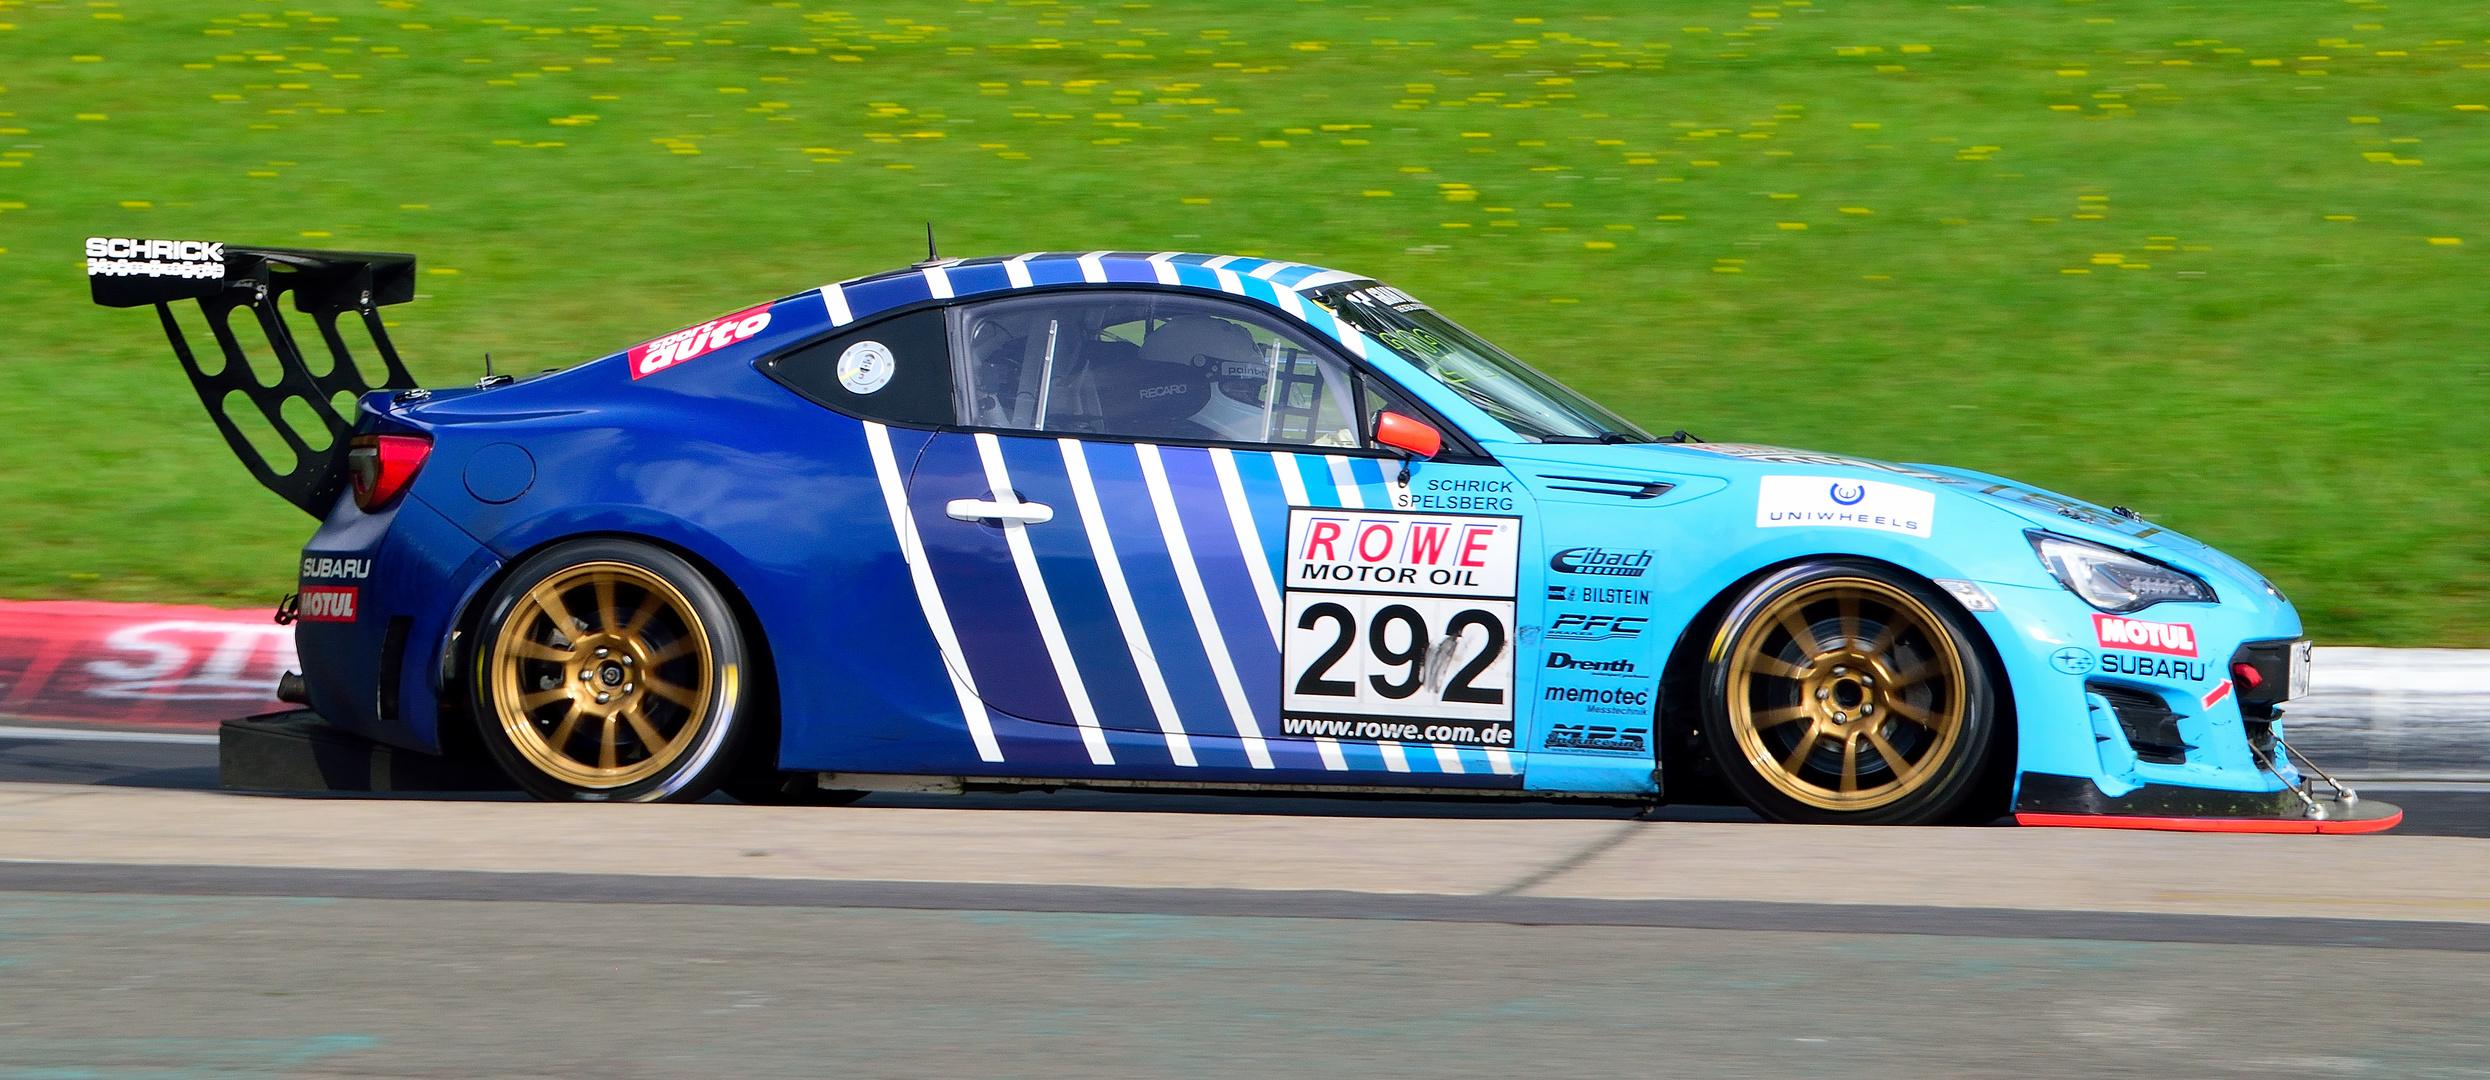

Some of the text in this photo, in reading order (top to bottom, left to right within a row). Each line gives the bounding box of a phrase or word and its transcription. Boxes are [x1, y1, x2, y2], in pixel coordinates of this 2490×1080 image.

[86, 237, 224, 262] SCHRICK
[640, 312, 772, 374] auto
[646, 320, 717, 355] sport
[1228, 365, 1269, 376] point-r
[1139, 384, 1187, 399] RECARO
[1427, 479, 1513, 493] SCHRICK
[1397, 494, 1513, 511] SPELSBERG
[1770, 511, 1918, 530] UNIWHEELS
[1305, 521, 1494, 568] ROWE
[303, 557, 371, 579] SUBARU
[1550, 547, 1653, 576] Eibach
[1301, 563, 1480, 587] MOTOR OIL
[301, 592, 354, 617] MOTUL
[1583, 587, 1649, 605] BILSTEIN
[1551, 614, 1649, 634] PFC
[2101, 618, 2193, 650] MOTUL
[1294, 601, 1506, 706] 292
[1546, 652, 1634, 673] Drenth
[2101, 654, 2205, 682] SUBARU
[1544, 686, 1648, 706] memotec
[1283, 717, 1513, 745] www.rowe.com.de
